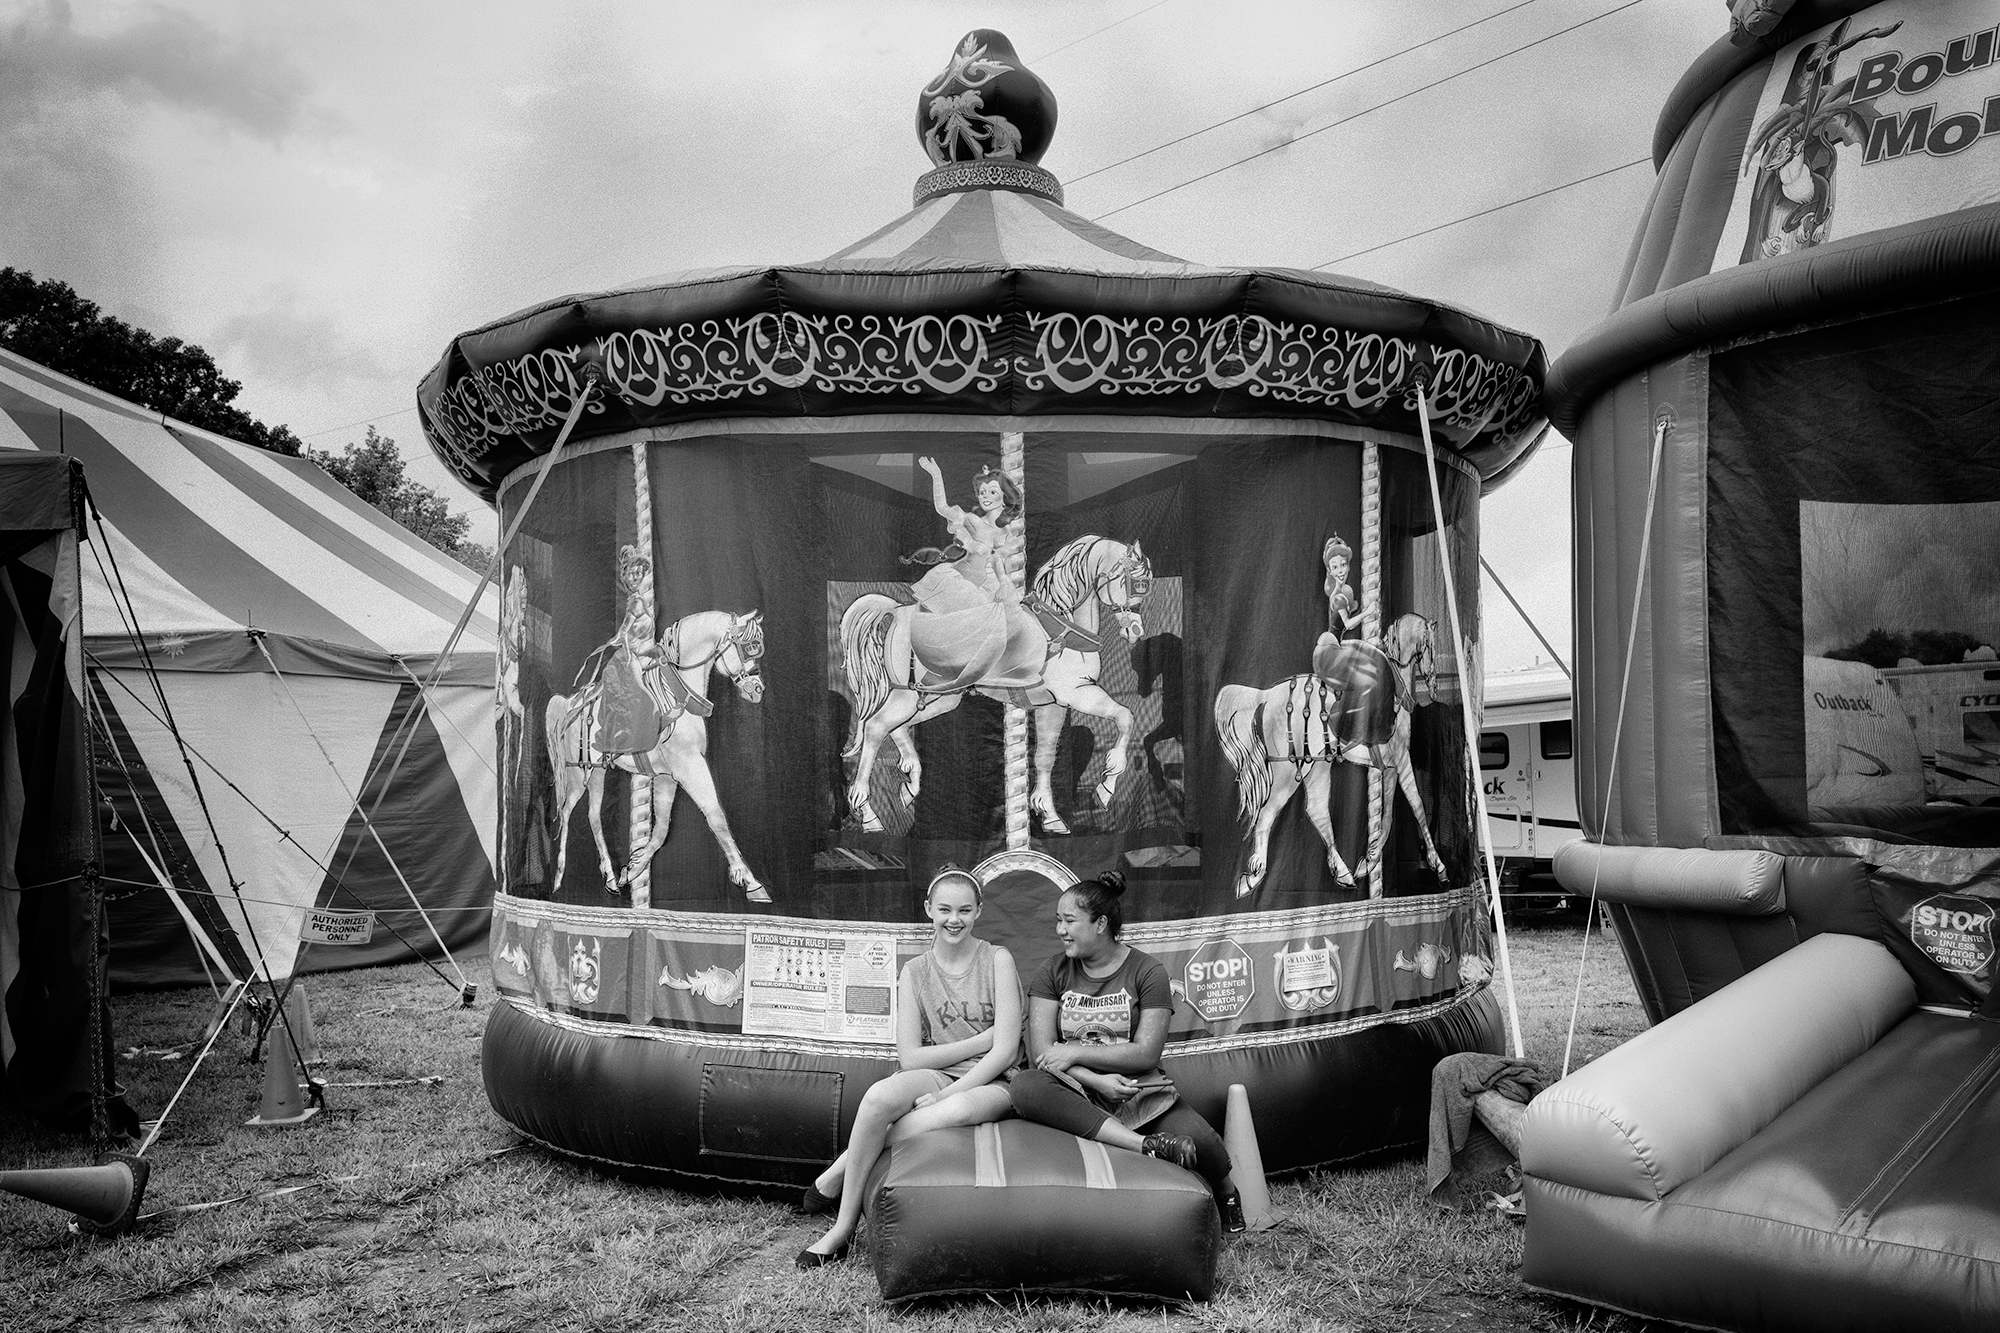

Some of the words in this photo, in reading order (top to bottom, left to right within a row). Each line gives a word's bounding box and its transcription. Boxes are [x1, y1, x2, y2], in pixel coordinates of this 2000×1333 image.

[1849, 23, 2000, 105] Bou
[1861, 94, 2000, 167] Mo
[1814, 692, 1872, 711] Outback
[1960, 694, 2000, 707] CYC
[1484, 776, 1505, 795] ck
[311, 914, 368, 926] AUTHORIZED
[312, 923, 366, 933] PERSONNEL
[327, 933, 351, 941] ONLY
[753, 934, 778, 944] PATRON
[778, 936, 804, 946] SAFETY
[805, 939, 825, 948] RULES
[1924, 928, 1937, 936] DO
[1940, 931, 1960, 940] NOT
[1961, 934, 1985, 943] ENTER
[1939, 939, 1976, 951] UNLESS
[1926, 945, 1975, 959] OPERATOR
[1290, 954, 1321, 964] WARNING
[1935, 955, 1949, 964] ON
[1951, 957, 1976, 967] DUTY
[1189, 956, 1248, 982] STOP!
[1197, 984, 1206, 992] DO
[1207, 982, 1221, 990] NOT
[1222, 979, 1246, 988] ENTER
[1207, 988, 1235, 998] UNLESS
[1078, 994, 1127, 1008] ANNIVERSARY
[1198, 997, 1236, 1007] OPERATOR
[1237, 995, 1244, 1003] IS
[1206, 1005, 1218, 1014] ON
[1219, 1003, 1238, 1012] DUTY
